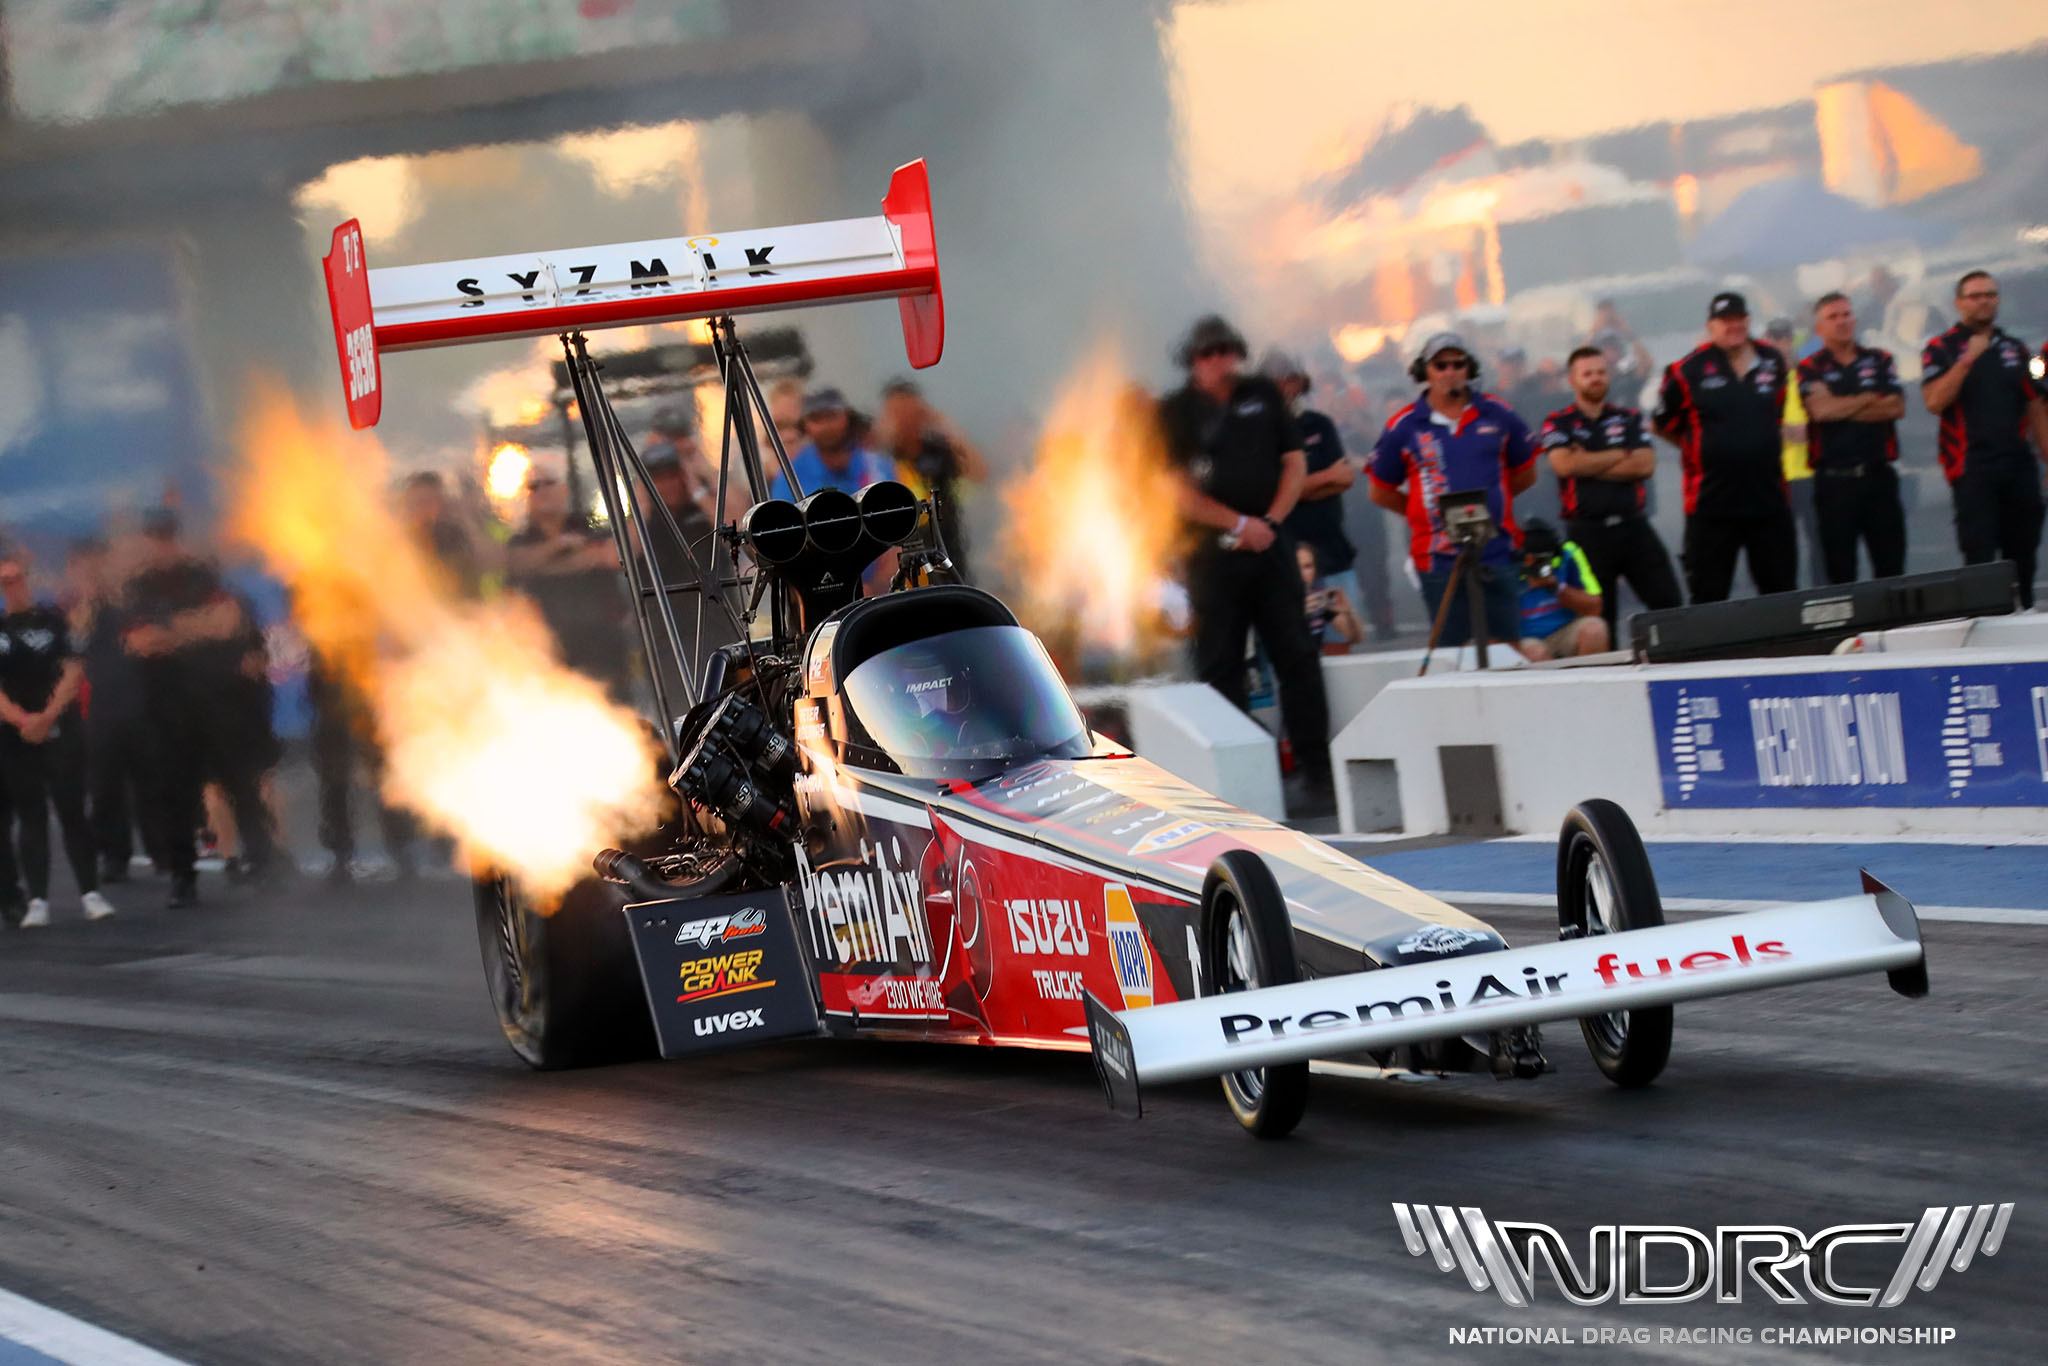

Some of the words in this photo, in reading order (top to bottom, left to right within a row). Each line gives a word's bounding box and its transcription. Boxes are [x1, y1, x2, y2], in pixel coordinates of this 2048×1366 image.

[343, 226, 359, 278] T/F
[457, 246, 782, 307] SYZMIK
[905, 677, 952, 694] IMPACT
[794, 836, 930, 963] PremiAir
[677, 915, 731, 948] SP
[1004, 899, 1089, 956] ISUZU
[680, 949, 763, 978] POWER
[1111, 930, 1149, 988] NAPA
[683, 965, 758, 992] CRANK
[884, 980, 909, 1009] 1300
[906, 980, 926, 1009] WE
[922, 980, 945, 1010] HIRE
[1032, 970, 1085, 1000] TRUCKS
[1220, 967, 1568, 1044] PremiAir
[1594, 934, 1792, 989] fuels
[694, 1008, 765, 1036] uvex
